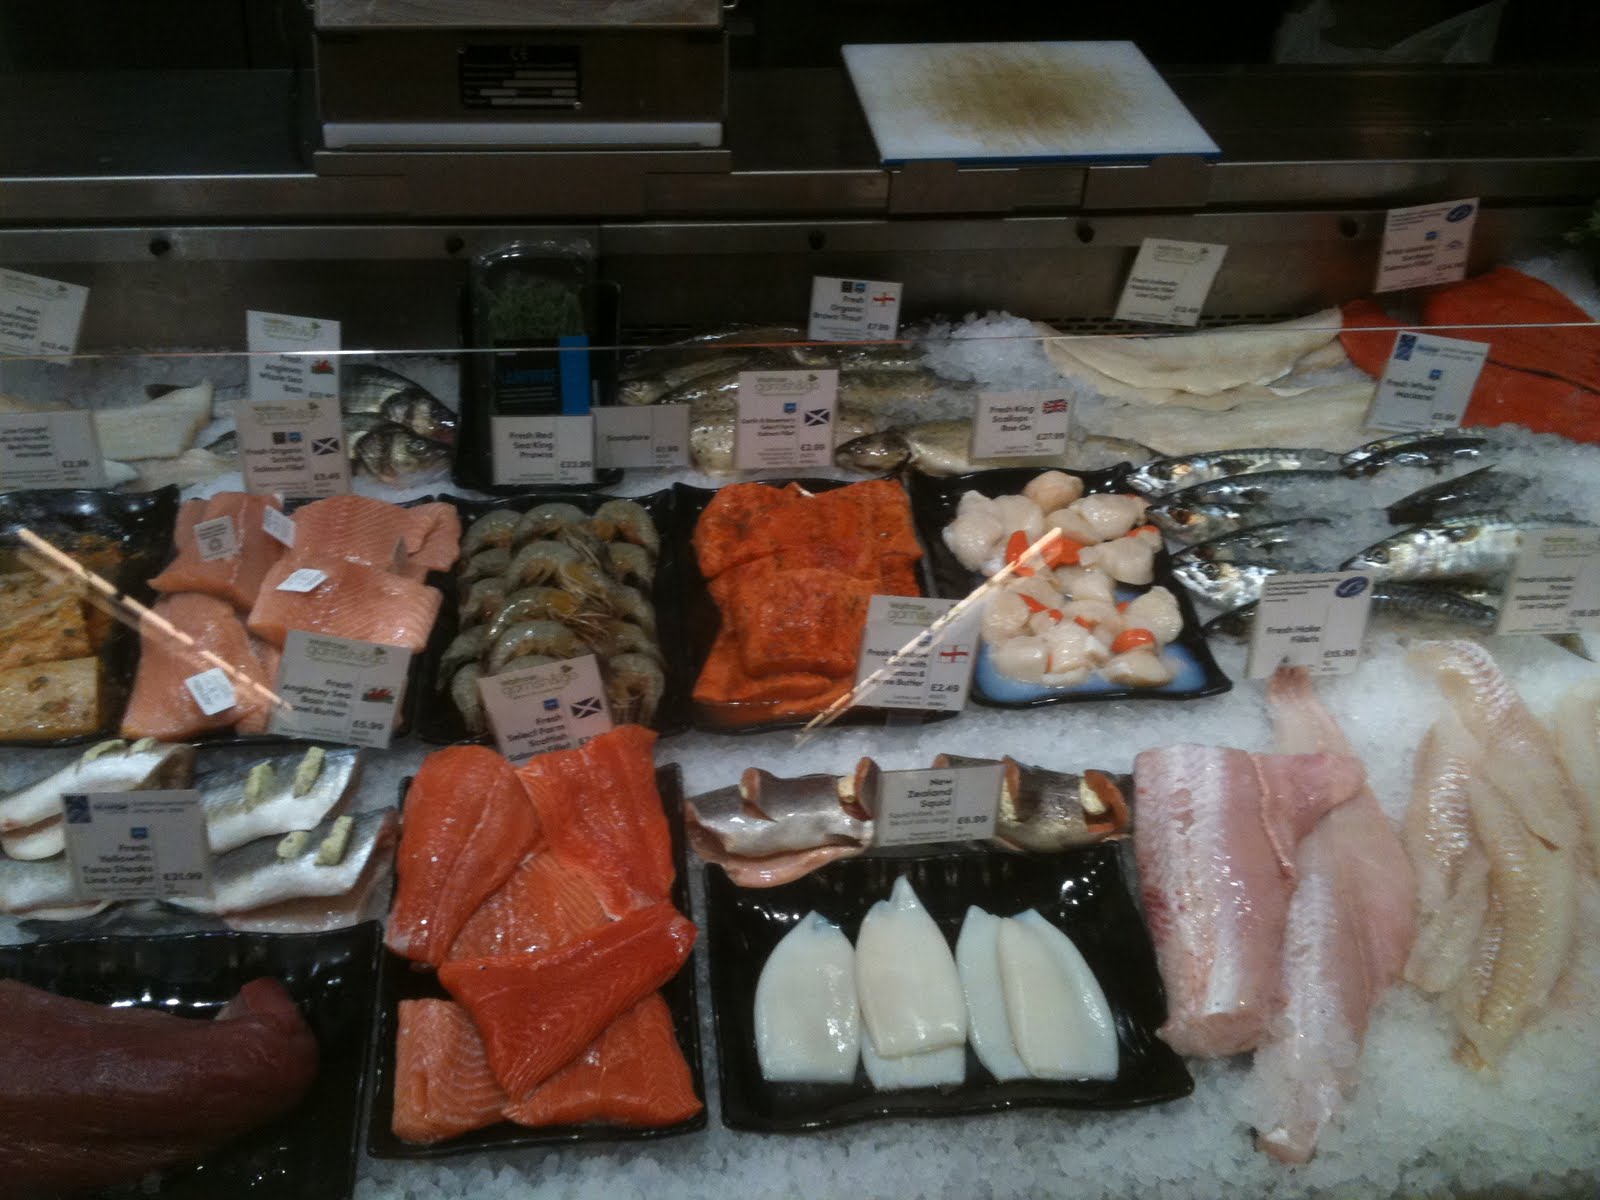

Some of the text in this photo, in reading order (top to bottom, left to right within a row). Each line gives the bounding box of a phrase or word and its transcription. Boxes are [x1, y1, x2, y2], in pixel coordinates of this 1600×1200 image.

[930, 683, 961, 693] £2.49
[929, 778, 952, 786] New
[907, 787, 953, 798] Zealand
[920, 799, 952, 809] Squid
